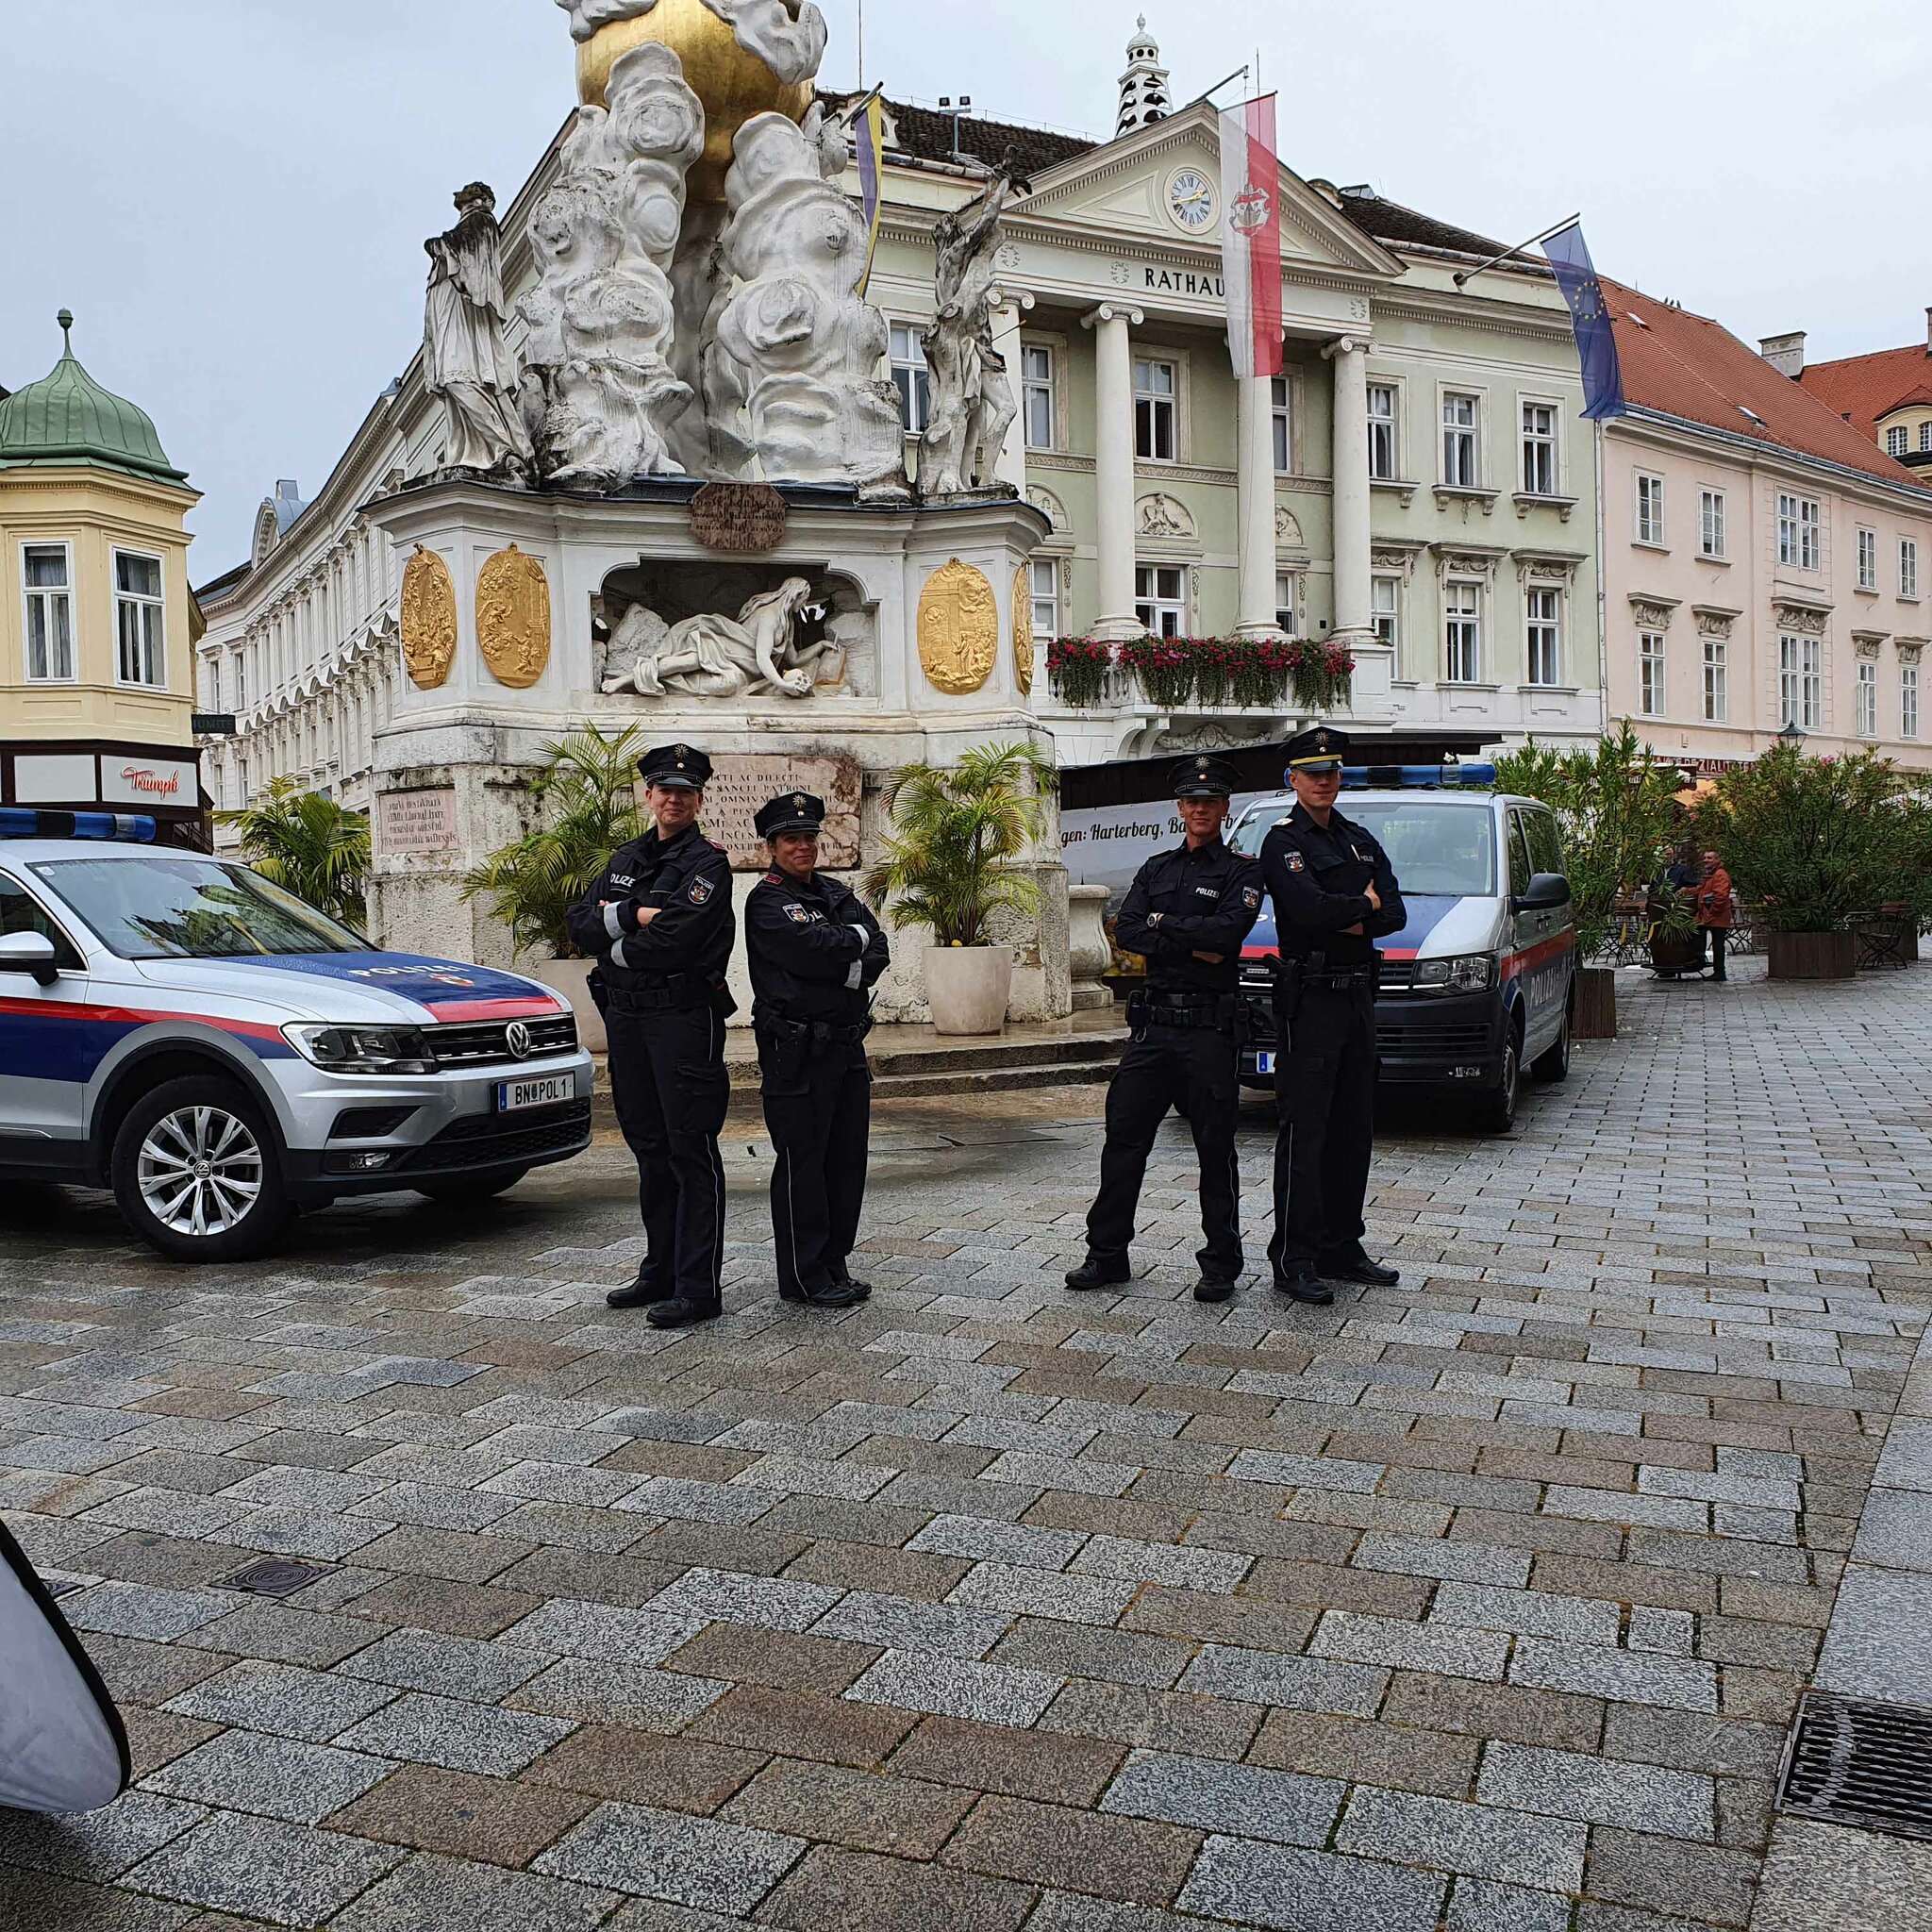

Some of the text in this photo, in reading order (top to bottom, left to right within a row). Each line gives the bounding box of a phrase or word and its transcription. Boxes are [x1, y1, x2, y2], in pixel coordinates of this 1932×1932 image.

[1145, 267, 1225, 297] RATHAU
[121, 766, 179, 800] Triumph
[740, 774, 752, 782] AC
[737, 819, 750, 828] AC
[1060, 815, 1187, 848] gen: Harterberg, Ba
[609, 873, 637, 888] OLIZE
[346, 965, 471, 978] POLIZEI
[515, 1077, 567, 1106] BN POL 1
